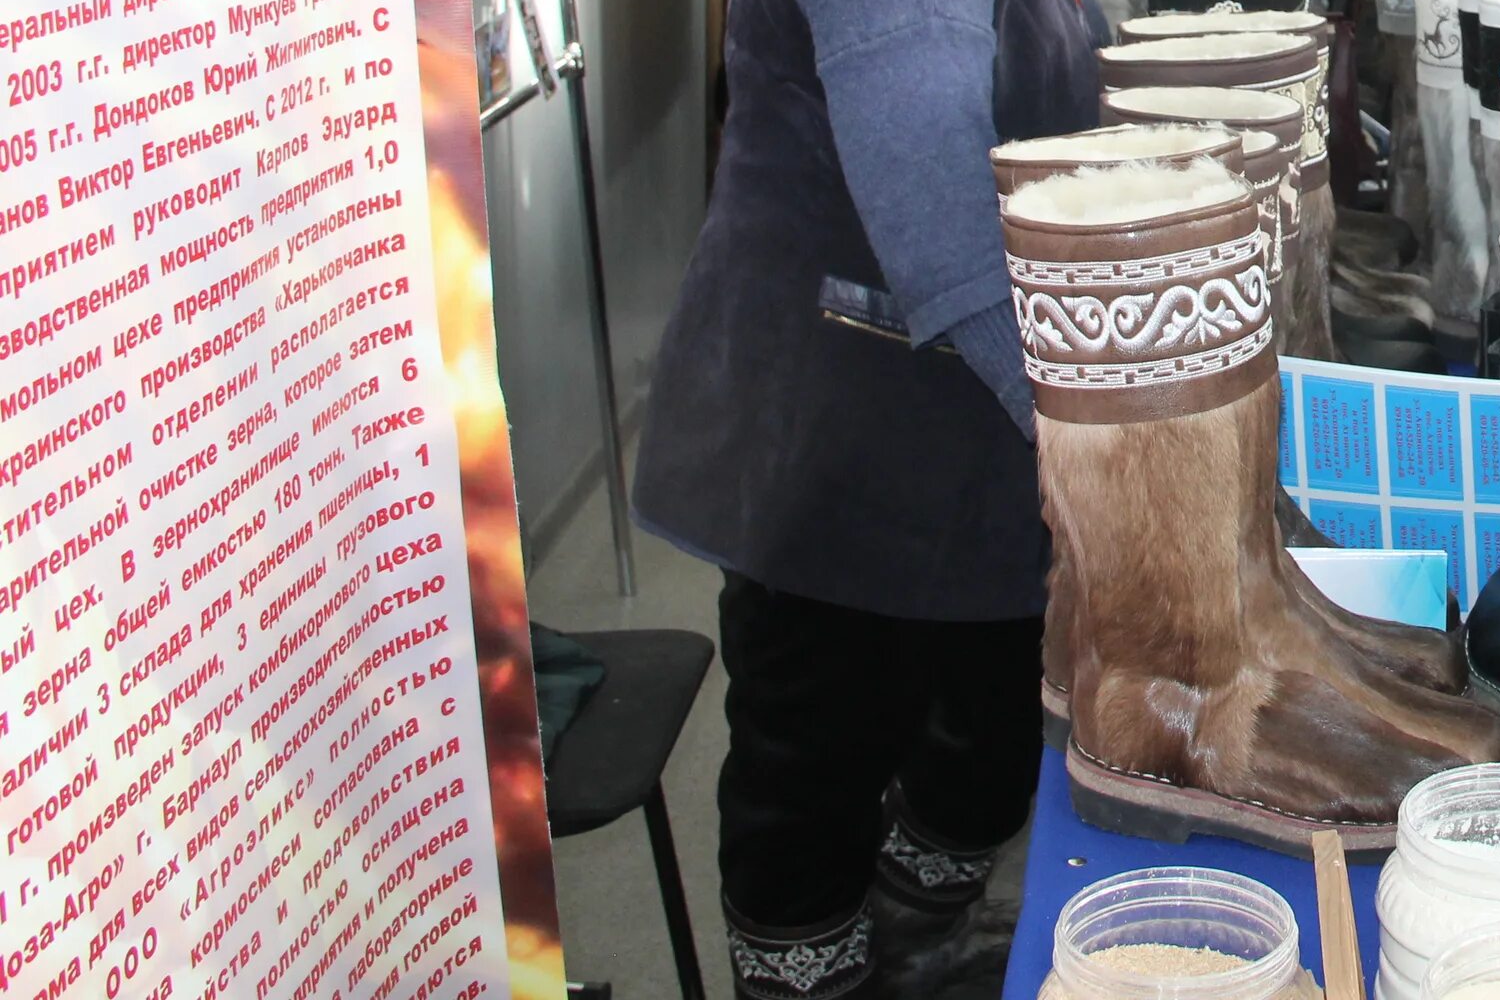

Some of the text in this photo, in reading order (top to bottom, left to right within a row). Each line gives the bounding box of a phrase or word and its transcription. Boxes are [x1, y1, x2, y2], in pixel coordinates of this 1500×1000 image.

[7, 60, 63, 107] 2003
[78, 55, 109, 83] г.г.
[123, 20, 216, 72] директор
[48, 122, 83, 152] г.г.
[93, 80, 195, 142] Дондоков
[204, 52, 258, 95] Юрий
[265, 20, 362, 72] Жигмитович.
[373, 7, 390, 32] С
[58, 158, 134, 209] Виктор
[142, 110, 259, 172] Евгеньевич.
[266, 94, 275, 121] С
[281, 76, 313, 114] 2012
[319, 77, 330, 95] г.
[345, 66, 355, 85] и
[365, 58, 393, 79] по
[133, 168, 241, 241] руководит
[257, 133, 308, 177] Карпов
[322, 102, 397, 141] Эдуард
[0, 189, 402, 423] мольном цехе предприятия установлены
[141, 306, 266, 398] производства
[275, 233, 406, 312] «Харьковчанка
[160, 215, 254, 276] мощность
[261, 159, 354, 224] предприятия
[365, 140, 399, 172] 1,0
[0, 276, 409, 549] тительном отделении располагается
[1, 357, 418, 674] ый цех. В зернохранилище имеются 6
[139, 444, 217, 511] очистке
[228, 402, 277, 451] зерна,
[284, 352, 341, 407] которое
[349, 320, 413, 360] затем
[24, 647, 92, 717] зерна
[104, 579, 171, 652] общей
[182, 509, 266, 591] емкостью
[274, 474, 301, 514] 180
[308, 448, 345, 486] тонн.
[352, 407, 424, 450] Также
[98, 683, 110, 715] 3
[120, 624, 192, 696] склада
[200, 589, 232, 638] для
[239, 520, 313, 600] хранения
[319, 460, 399, 529] пшеницы,
[415, 443, 429, 467] 1
[7, 491, 435, 856] готовой продукции, 3 единицы грузового
[20, 533, 442, 906] г. произведен запуск комбикормового цеха
[137, 829, 151, 856] г.
[163, 739, 242, 829] Барнаул
[251, 575, 445, 743] производительностью
[89, 615, 448, 970] для всех видов сельскохозяйственных
[106, 657, 452, 1000] ООО «Агроэликс» полностью
[191, 697, 456, 968] кормосмеси согласована с
[257, 778, 464, 1000] полностью оснащена
[277, 736, 460, 924] и продовольствия
[365, 818, 469, 920] и получена
[348, 858, 473, 993] лабораторные
[404, 892, 477, 972] готовой
